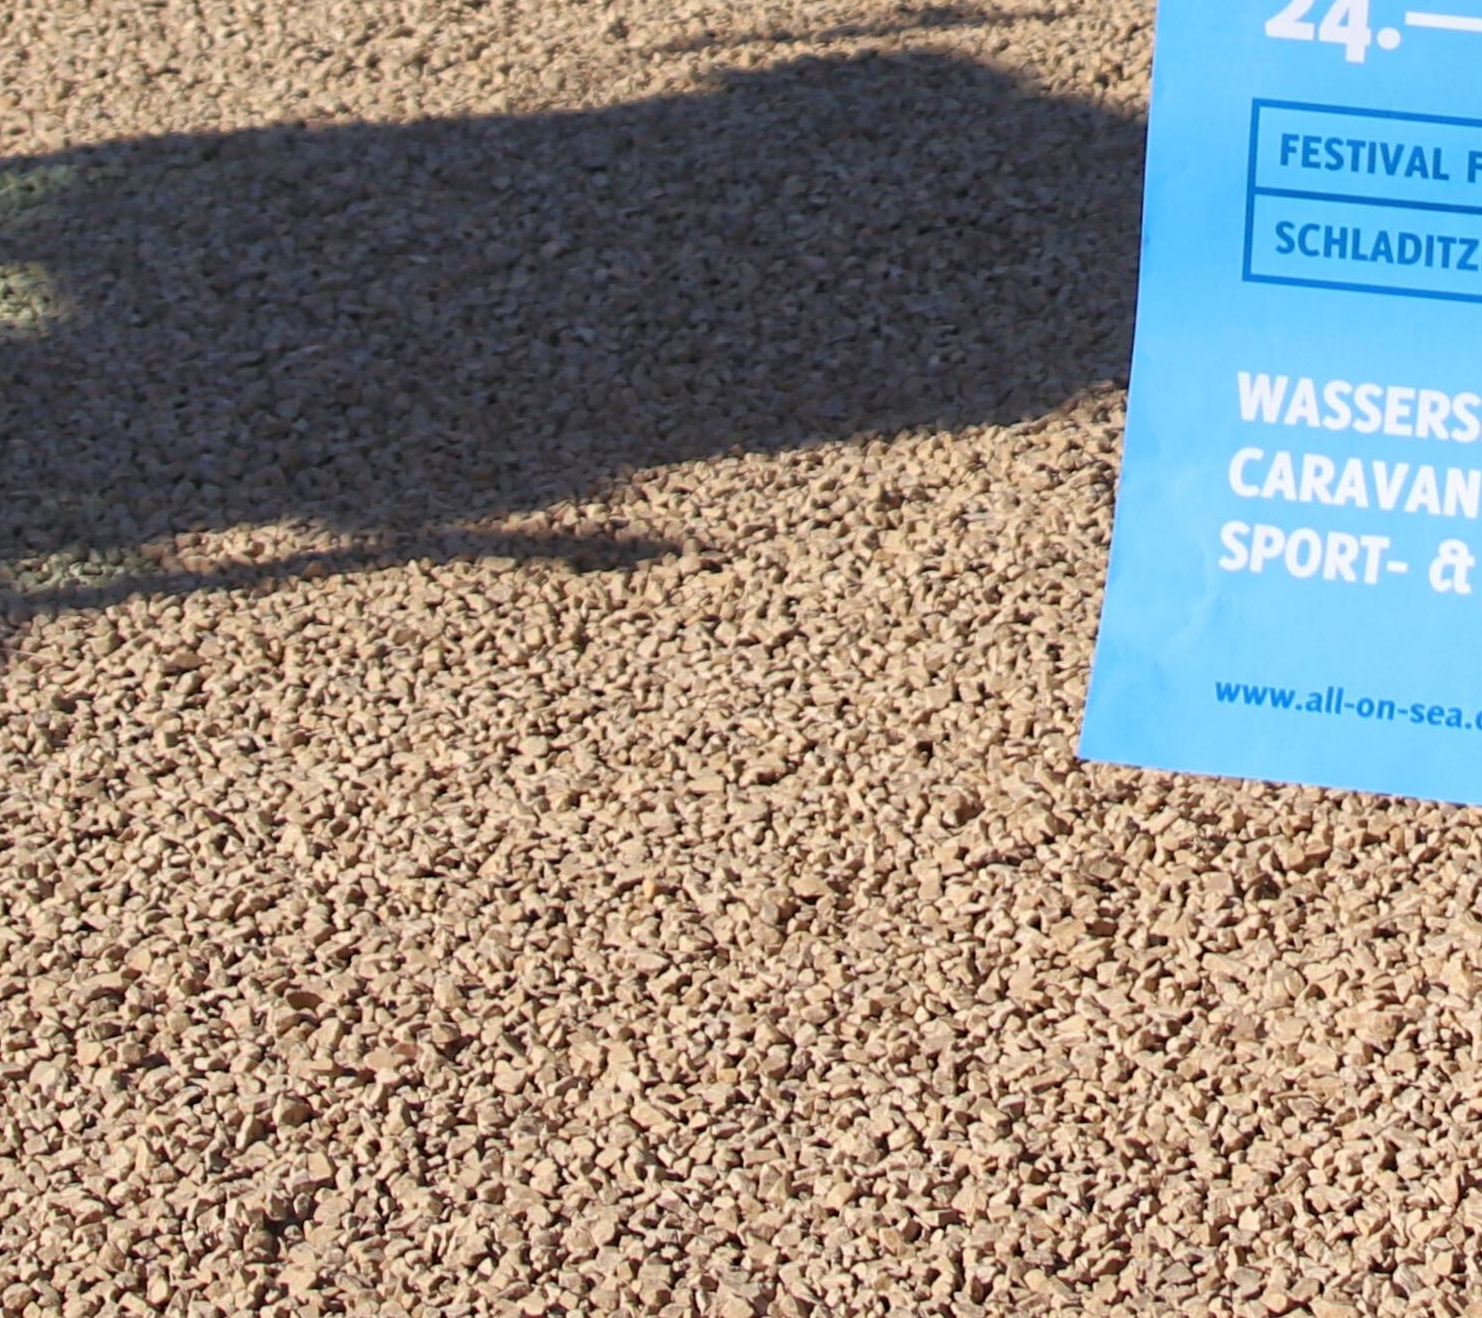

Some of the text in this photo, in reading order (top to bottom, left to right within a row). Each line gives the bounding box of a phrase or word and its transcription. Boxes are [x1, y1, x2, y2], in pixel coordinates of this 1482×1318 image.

[1279, 132, 1450, 181] FESTIVAL
[1227, 446, 1482, 520] CARAVAN
[1217, 520, 1409, 586] SPORT-
[1428, 538, 1476, 596] &
